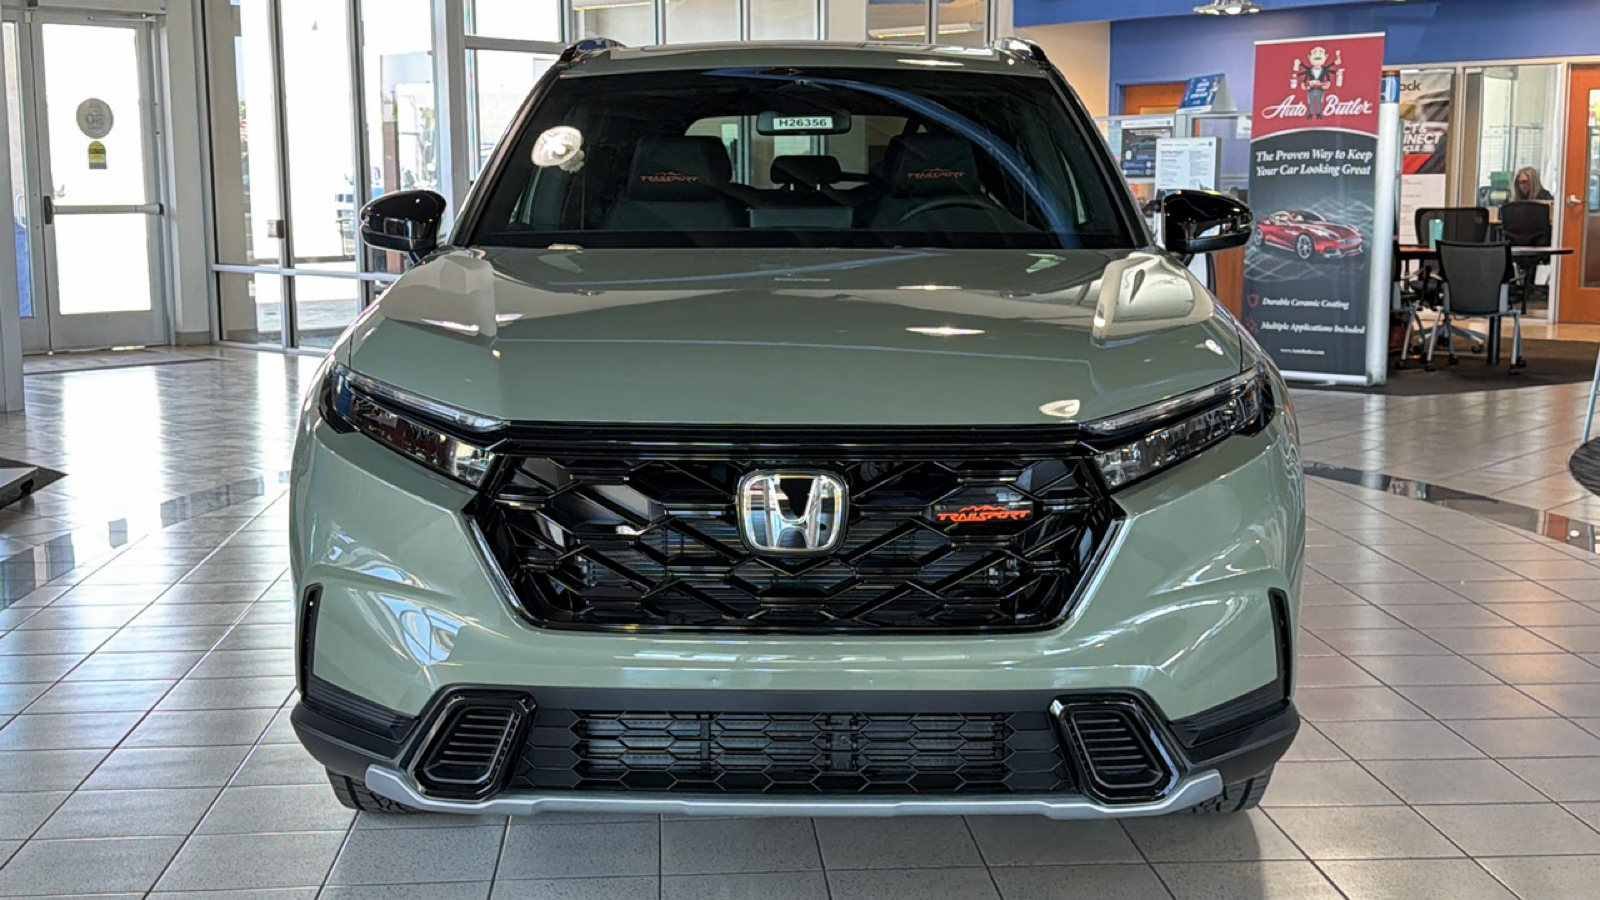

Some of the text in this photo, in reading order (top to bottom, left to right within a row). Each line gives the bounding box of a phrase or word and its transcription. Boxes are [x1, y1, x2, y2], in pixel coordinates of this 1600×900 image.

[1261, 94, 1374, 119] Auto Butler
[779, 118, 828, 128] H26356
[1256, 148, 1373, 163] The Proven Way to Keep
[1256, 163, 1372, 177] Your Car Looking Great
[1262, 297, 1350, 311] Durable Ceramic Coating
[1260, 320, 1366, 335] Multiple Applications Included
[937, 509, 1031, 523] TRAILSPORT
